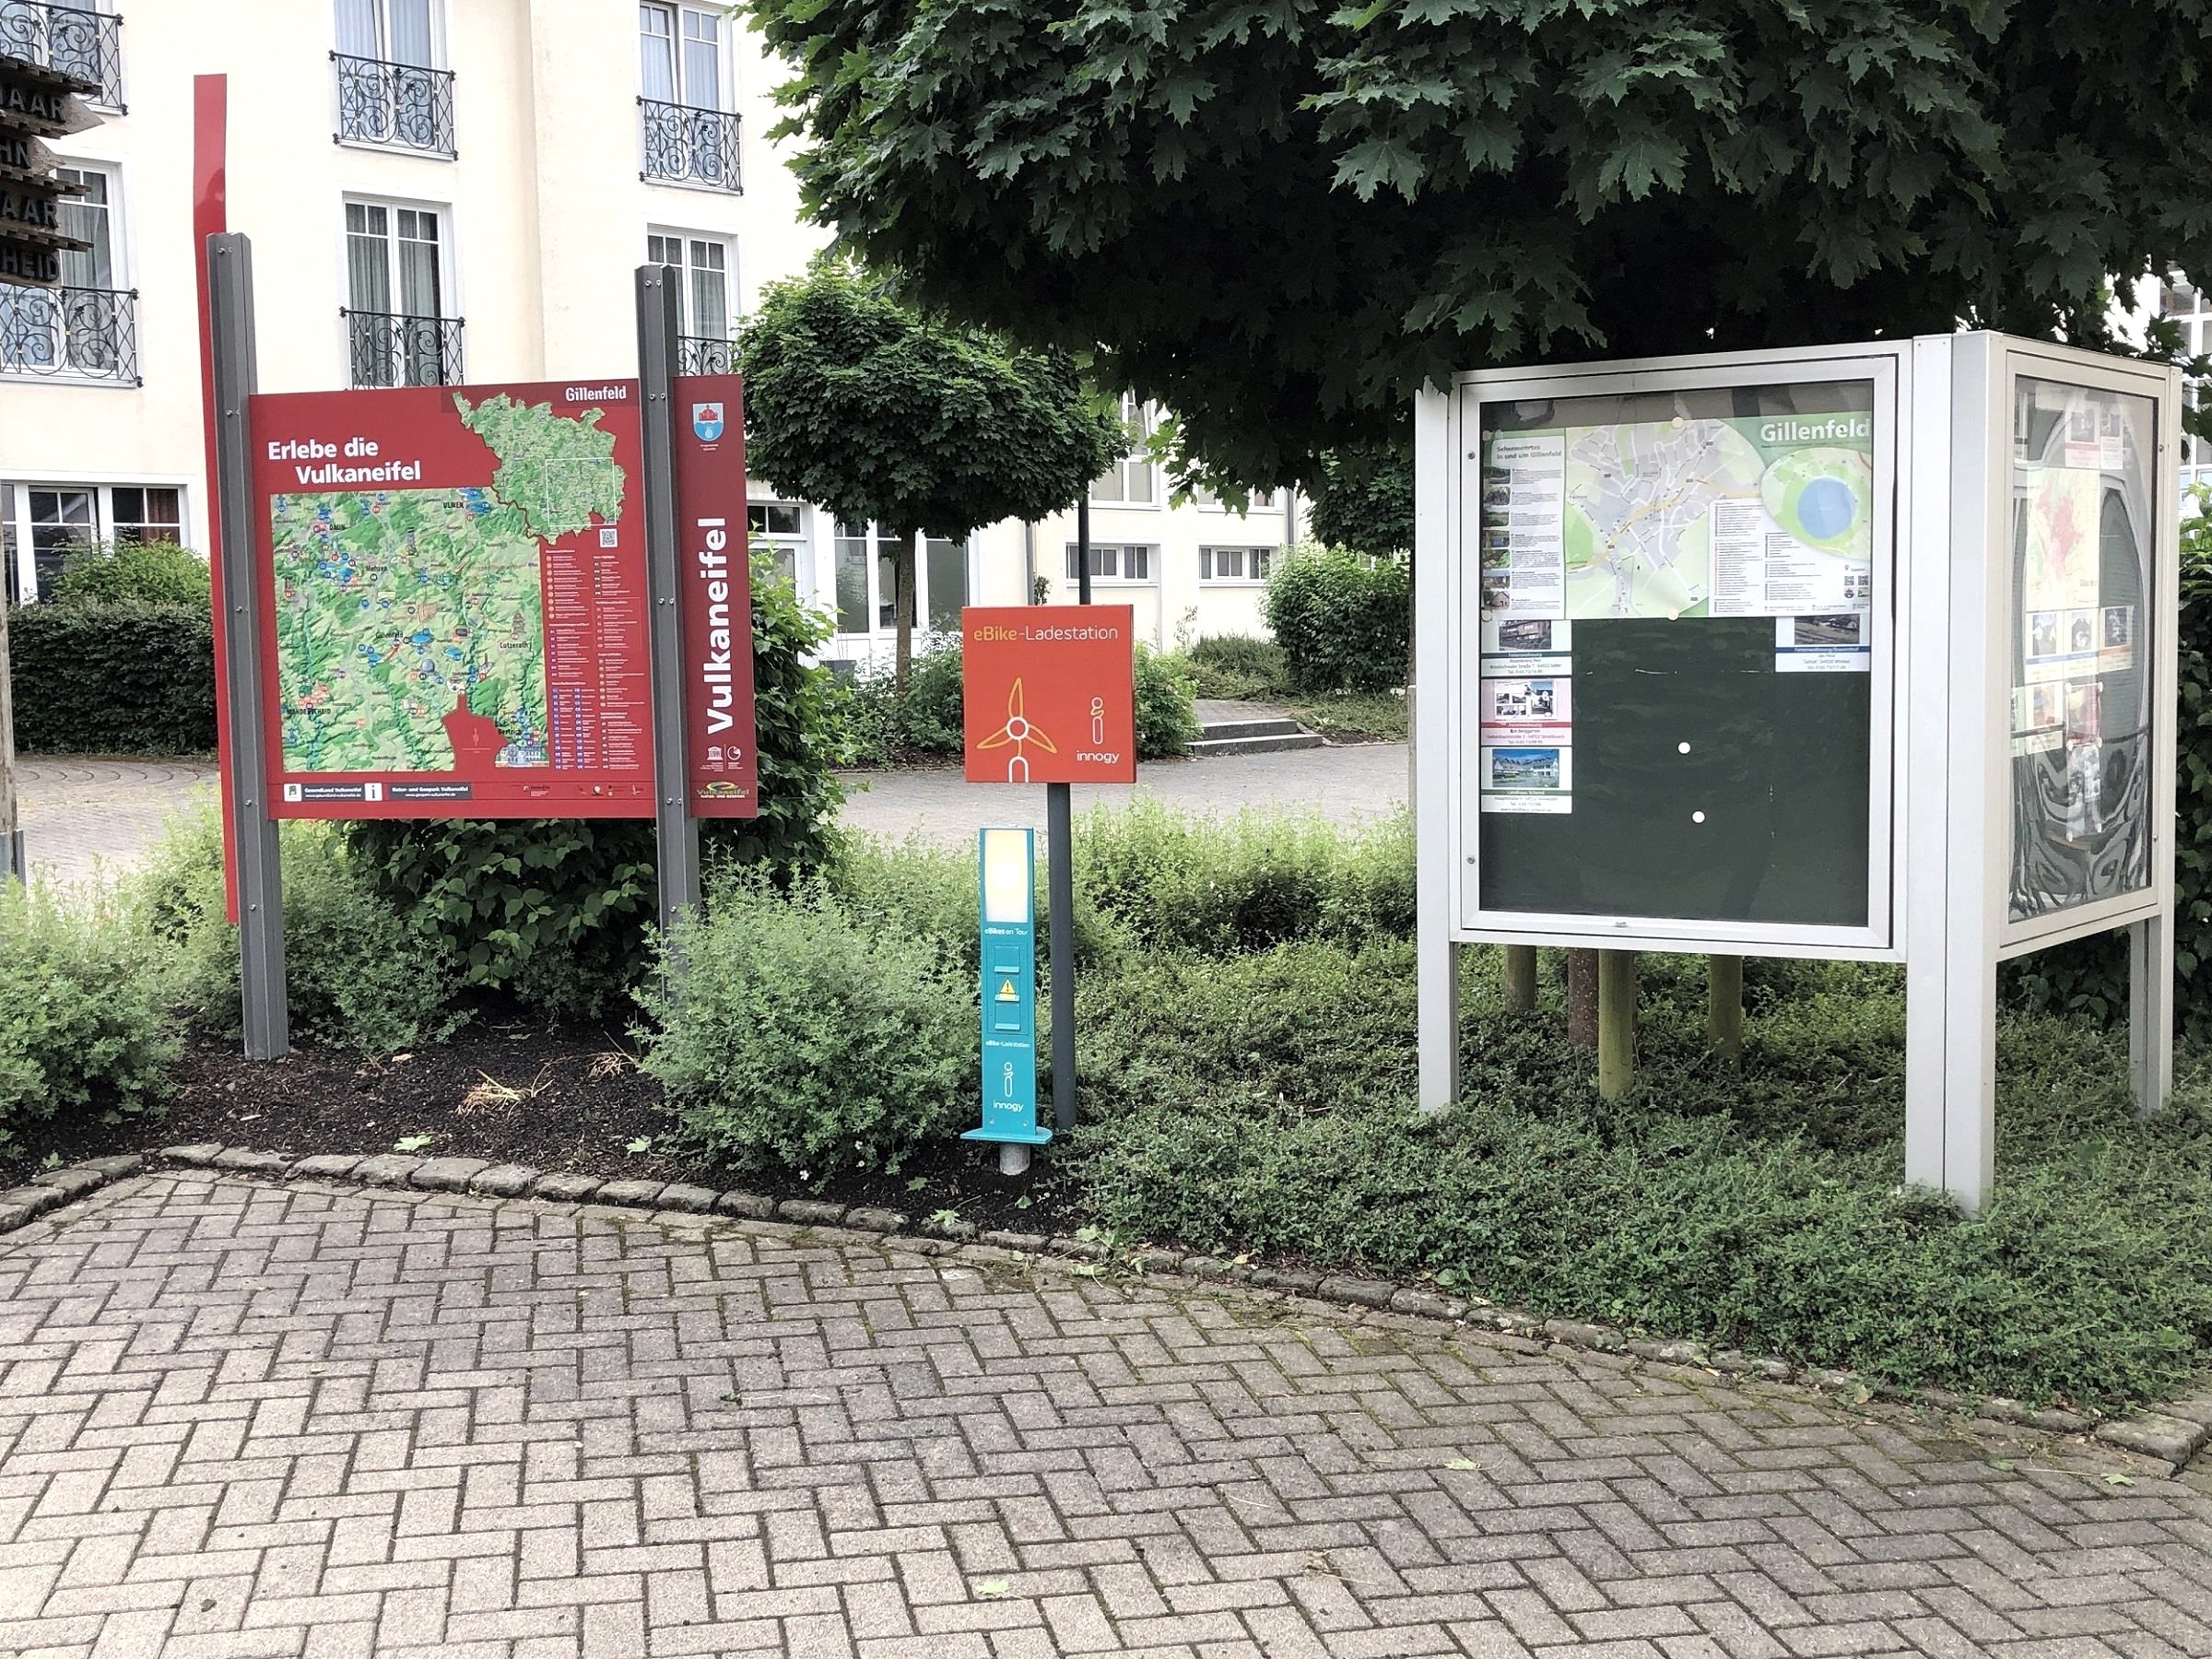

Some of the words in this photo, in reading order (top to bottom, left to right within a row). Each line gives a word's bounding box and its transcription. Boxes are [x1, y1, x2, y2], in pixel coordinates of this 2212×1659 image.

[0, 87, 67, 124] AAR
[565, 385, 627, 402] Gillenfeld
[1760, 418, 1871, 442] Gillenfeld
[268, 440, 337, 460] Erlebe
[344, 436, 379, 457] die
[295, 462, 421, 485] Vulkaneifel
[698, 518, 734, 735] Vulkaneifel
[973, 624, 1118, 641] eBike-Ladestation
[1077, 750, 1120, 763] innogy
[994, 1099, 1024, 1112] innogy
